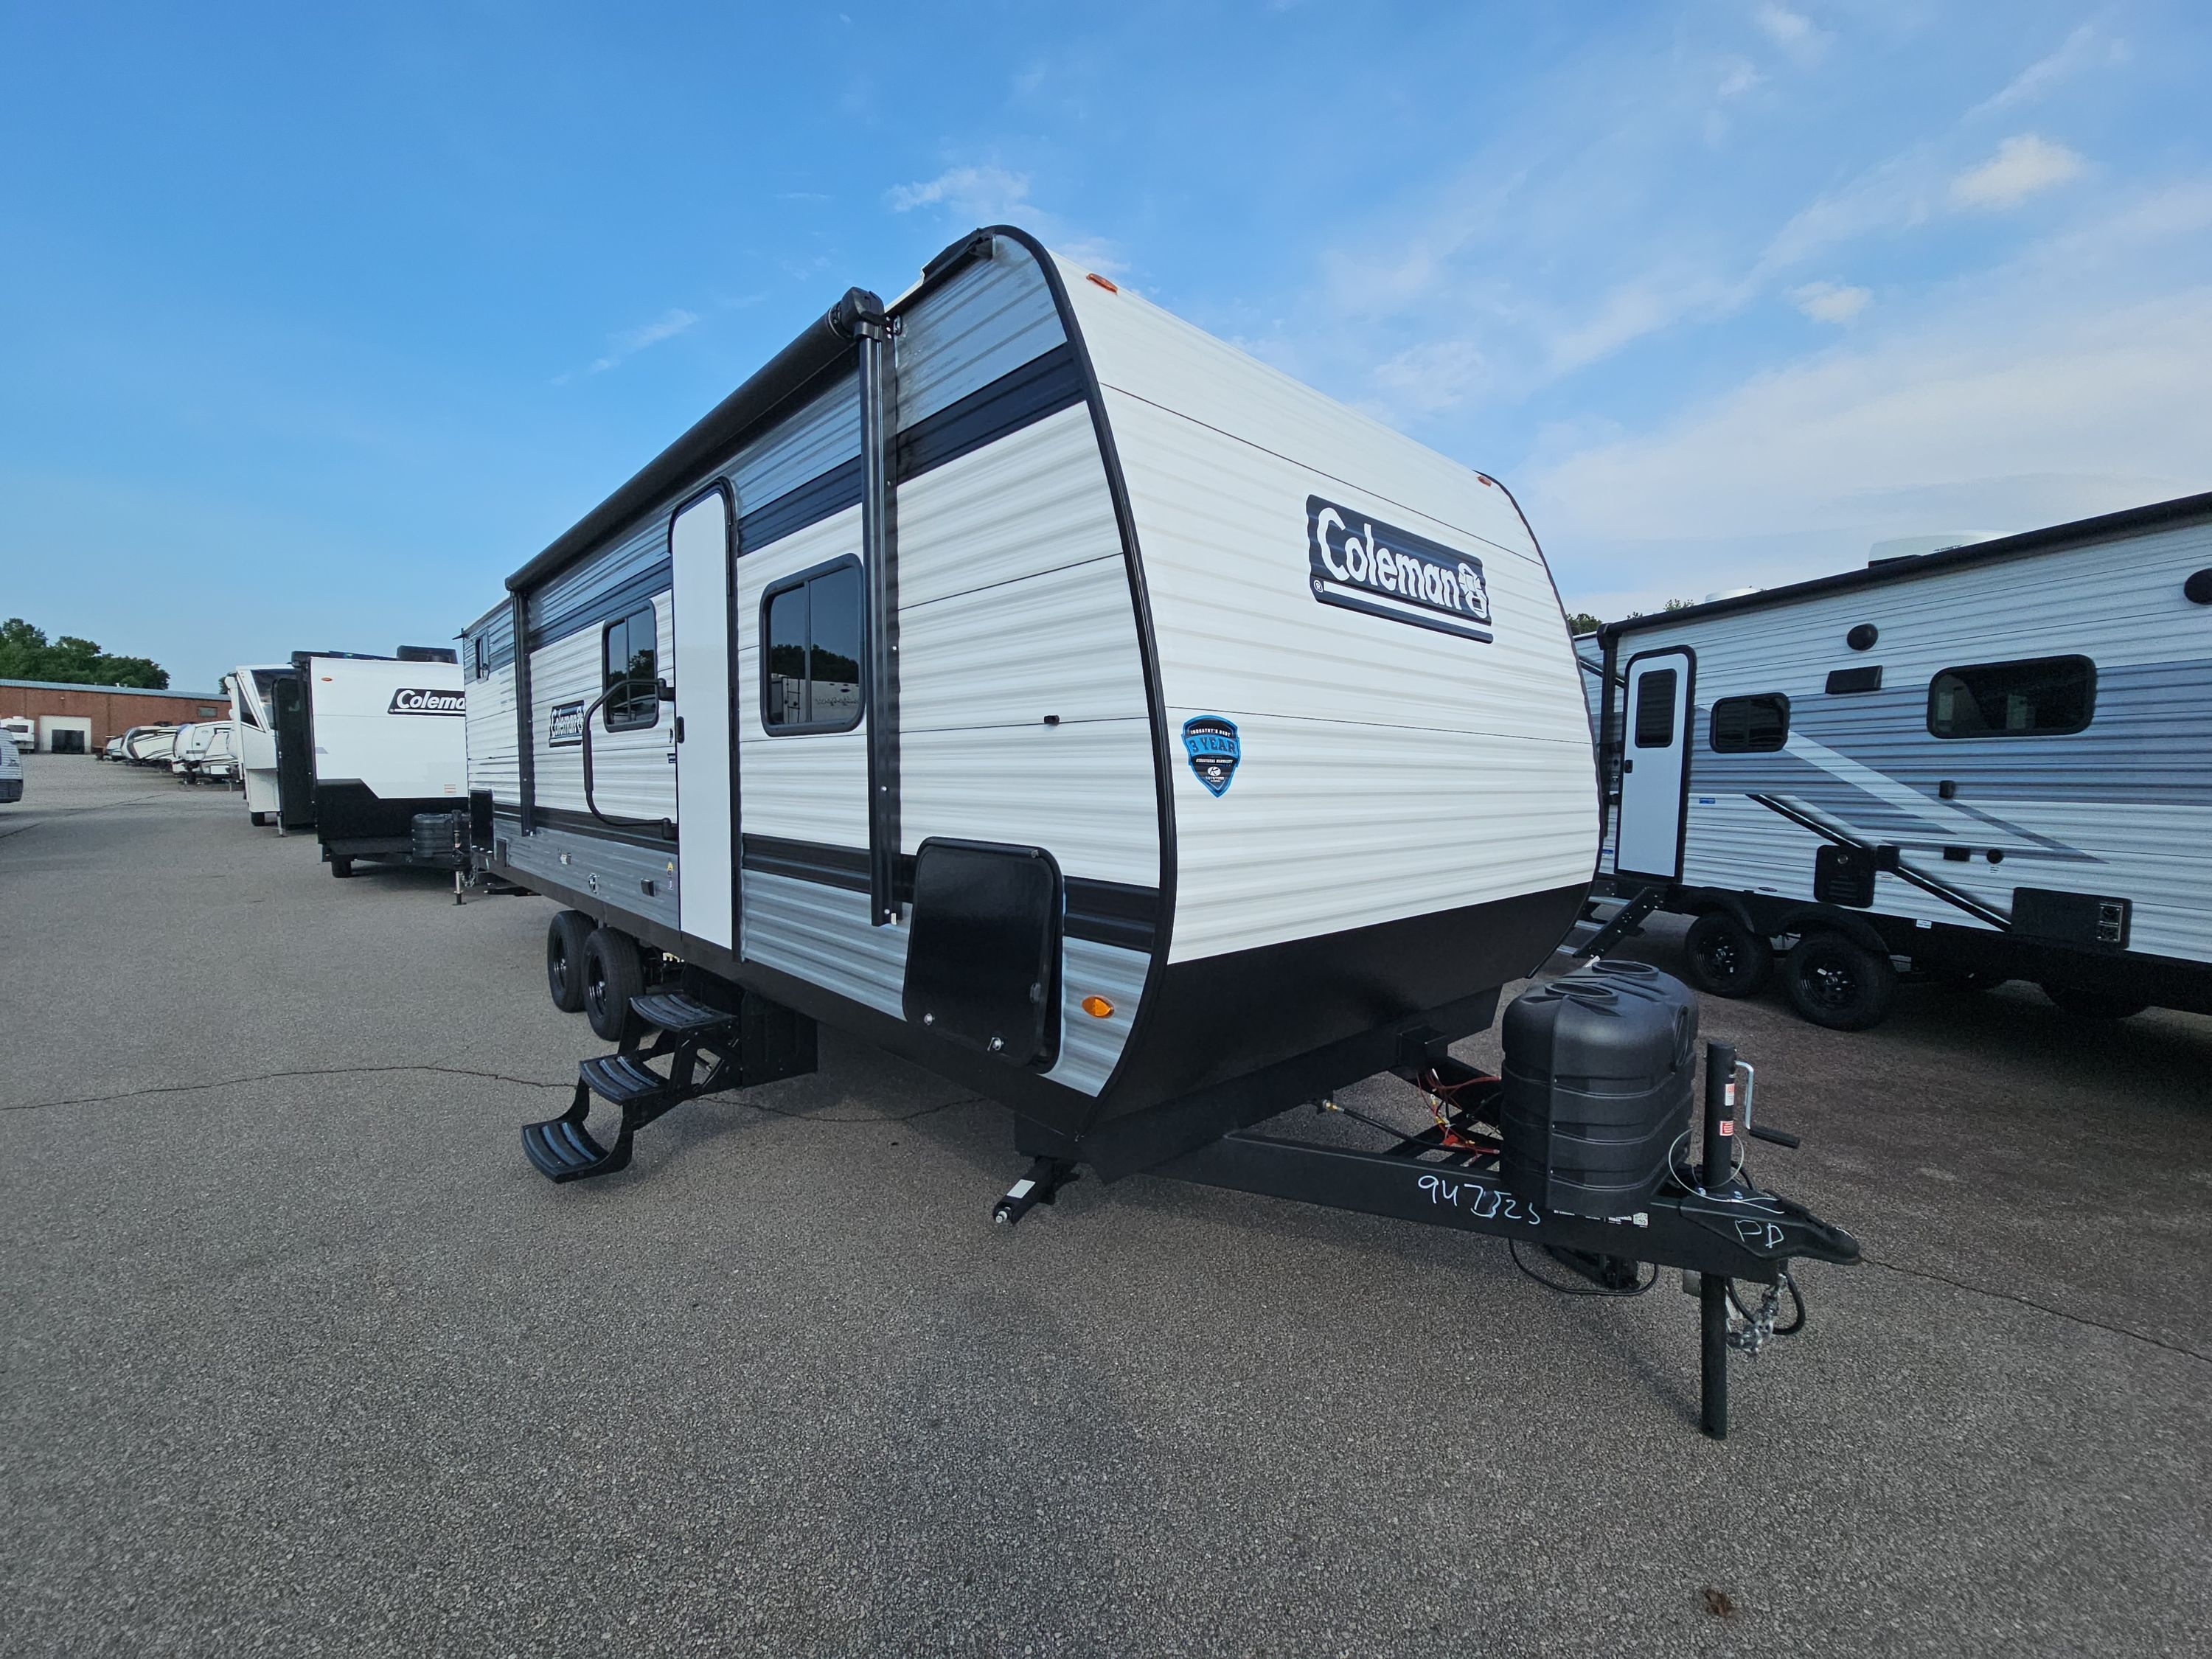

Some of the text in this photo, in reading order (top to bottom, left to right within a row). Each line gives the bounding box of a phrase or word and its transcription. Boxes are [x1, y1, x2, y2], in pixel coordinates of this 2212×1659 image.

[1317, 507, 1463, 611] Coleman
[396, 689, 466, 709] Colema
[551, 708, 577, 737] Coleman
[1189, 737, 1237, 755] 3 YEAR
